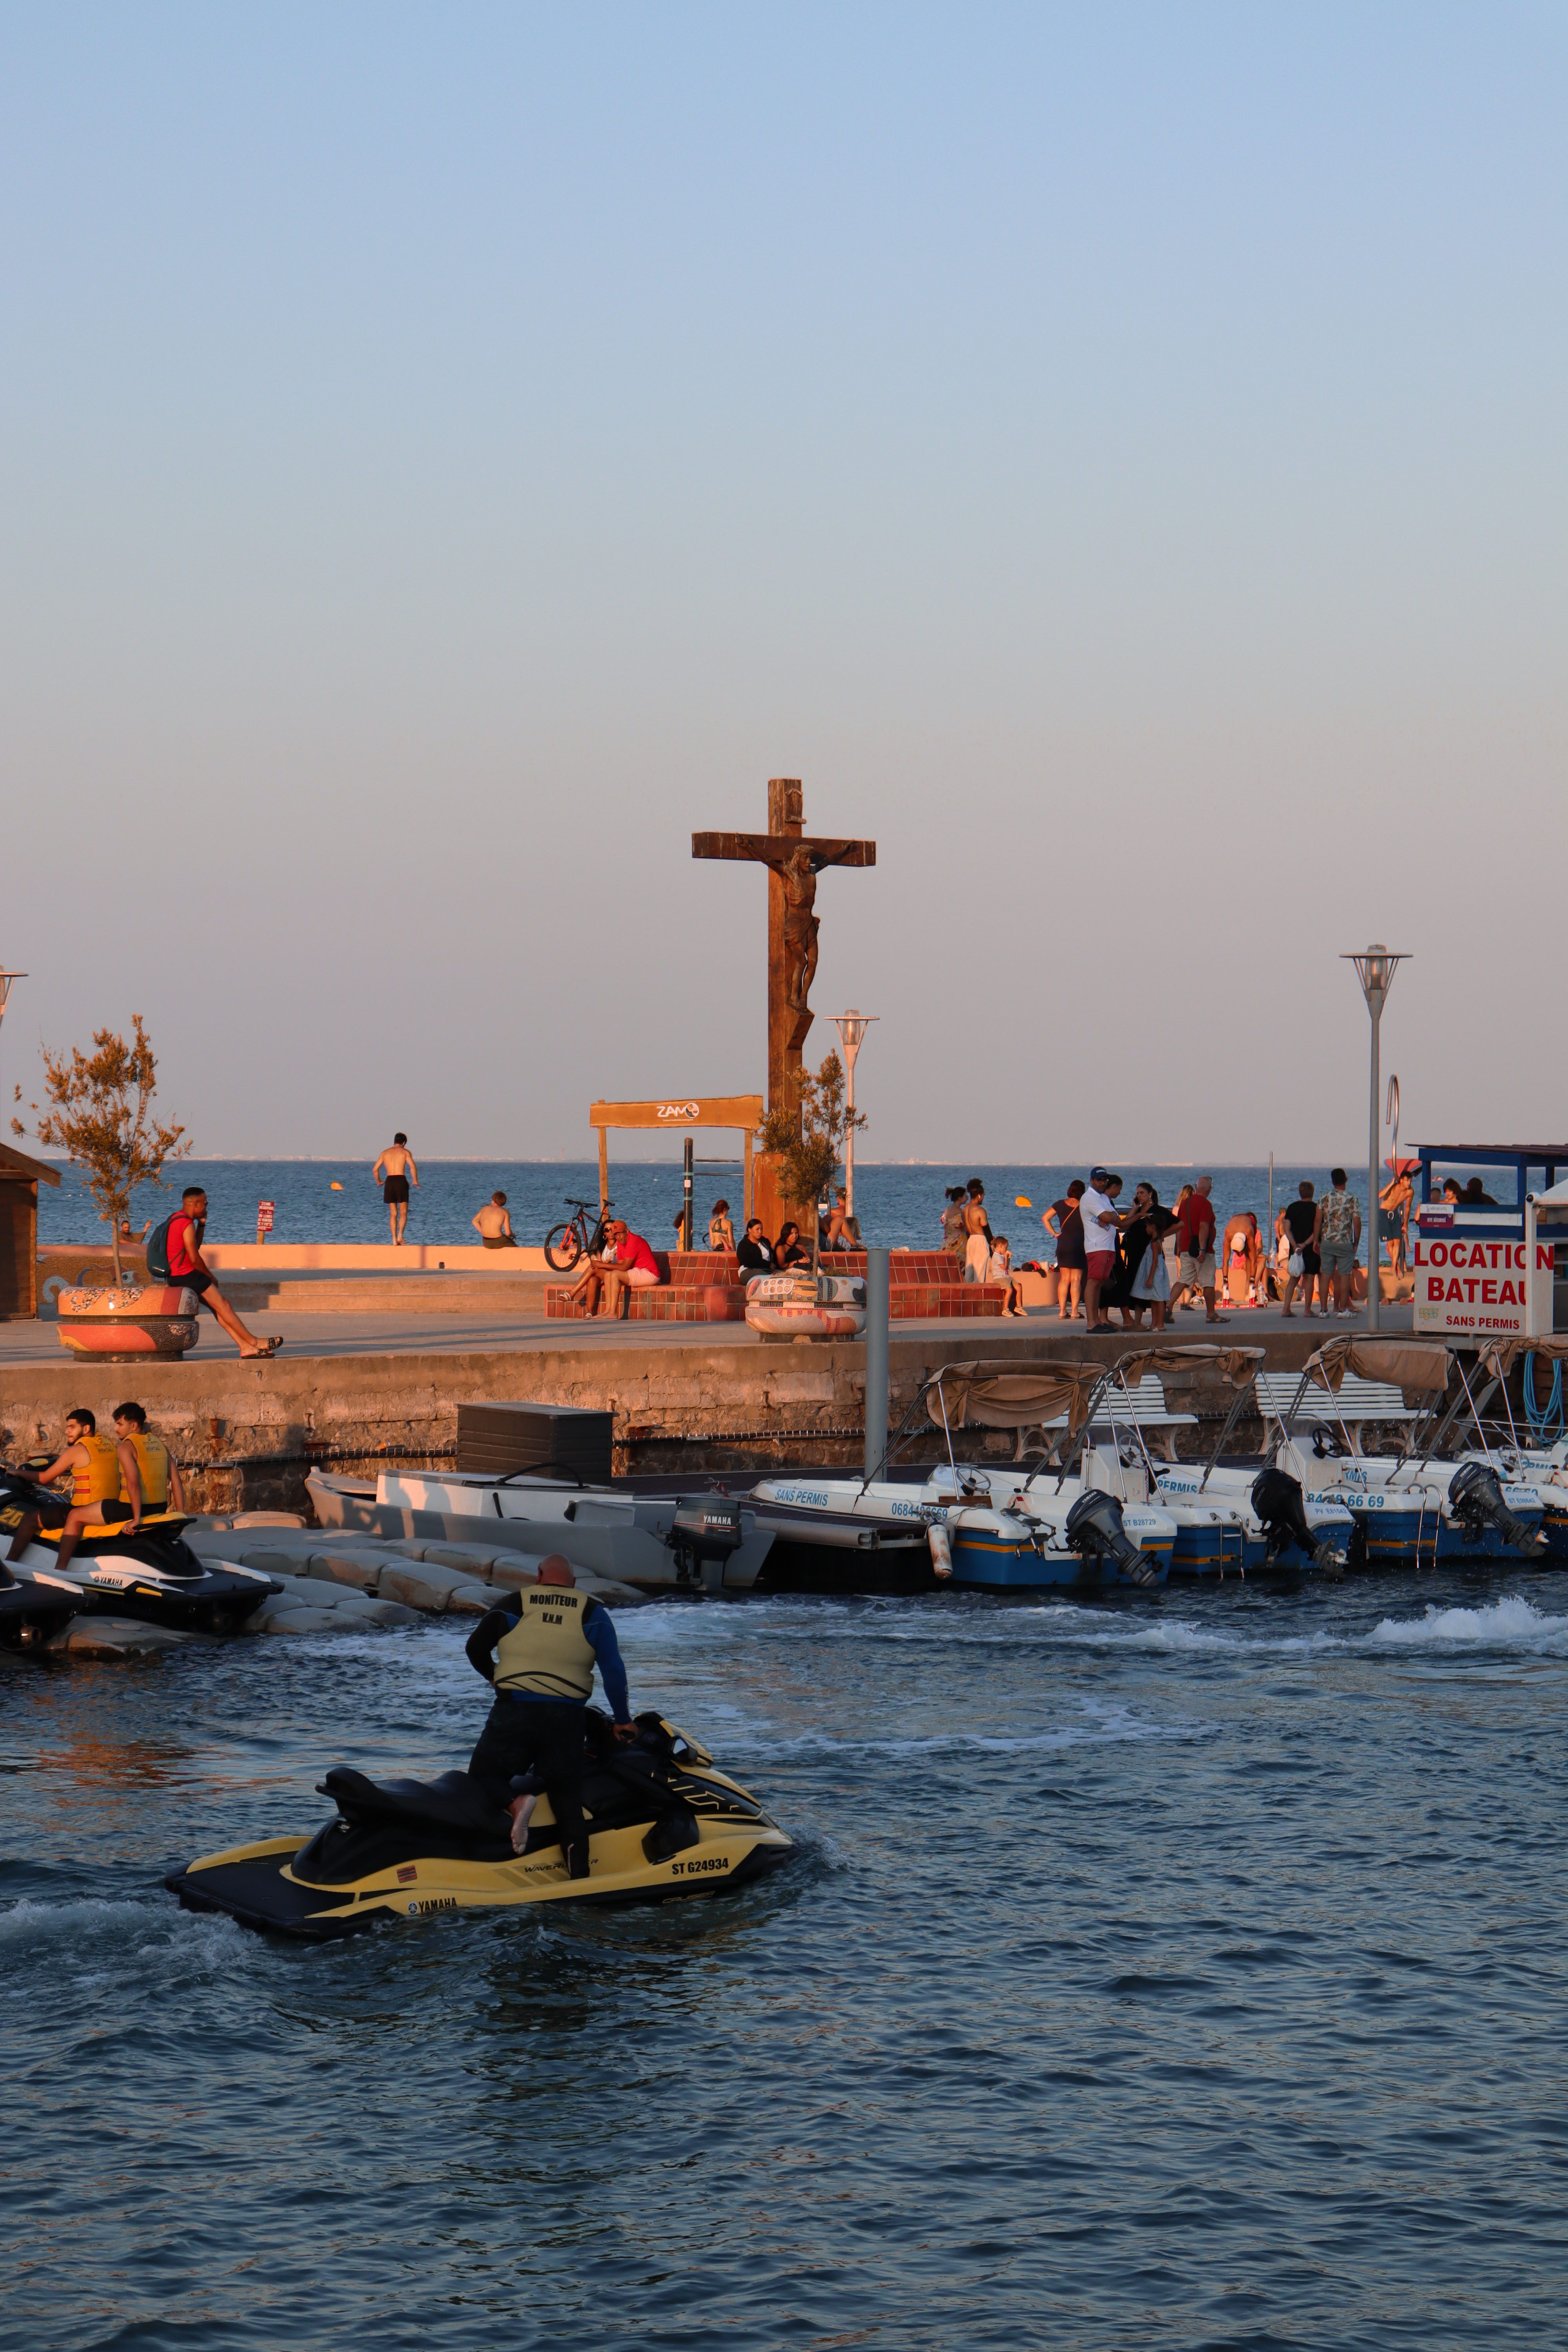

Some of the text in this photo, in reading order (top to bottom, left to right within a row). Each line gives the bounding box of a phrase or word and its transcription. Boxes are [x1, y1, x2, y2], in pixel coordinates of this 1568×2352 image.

[1414, 1242, 1554, 1270] LOCATION
[1446, 1316, 1520, 1330] SANS PERMIS
[775, 1489, 828, 1506] SANS PERMIS
[1082, 1491, 1097, 1503] YAMAHA
[1347, 1495, 1364, 1507] 66
[1368, 1495, 1385, 1508] 69
[703, 1515, 731, 1525] YAMAHA
[100, 1577, 123, 1587] YAMAHA
[530, 1594, 577, 1608] MONITEUR
[672, 1858, 729, 1875] ST G24934
[418, 1897, 457, 1913] YAMAHA
